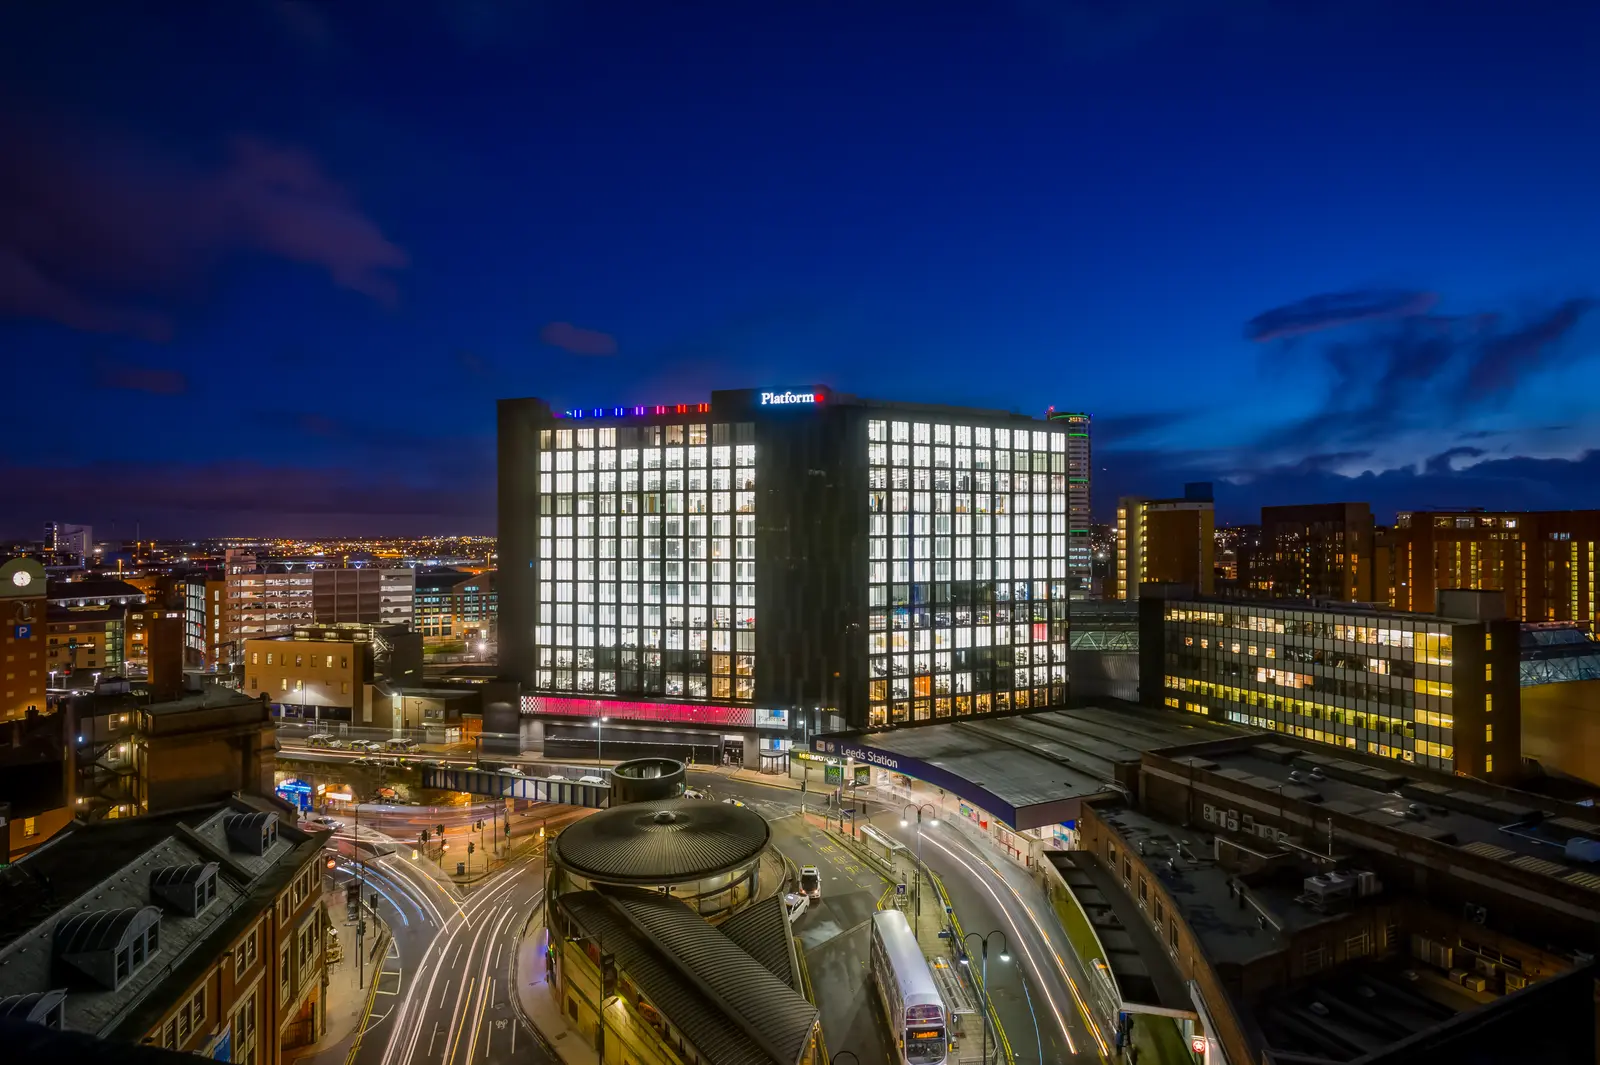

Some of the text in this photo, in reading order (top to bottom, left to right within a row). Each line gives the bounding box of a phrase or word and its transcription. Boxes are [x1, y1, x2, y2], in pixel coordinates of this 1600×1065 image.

[761, 391, 815, 405] Platform
[840, 744, 898, 769] Leeds Station
